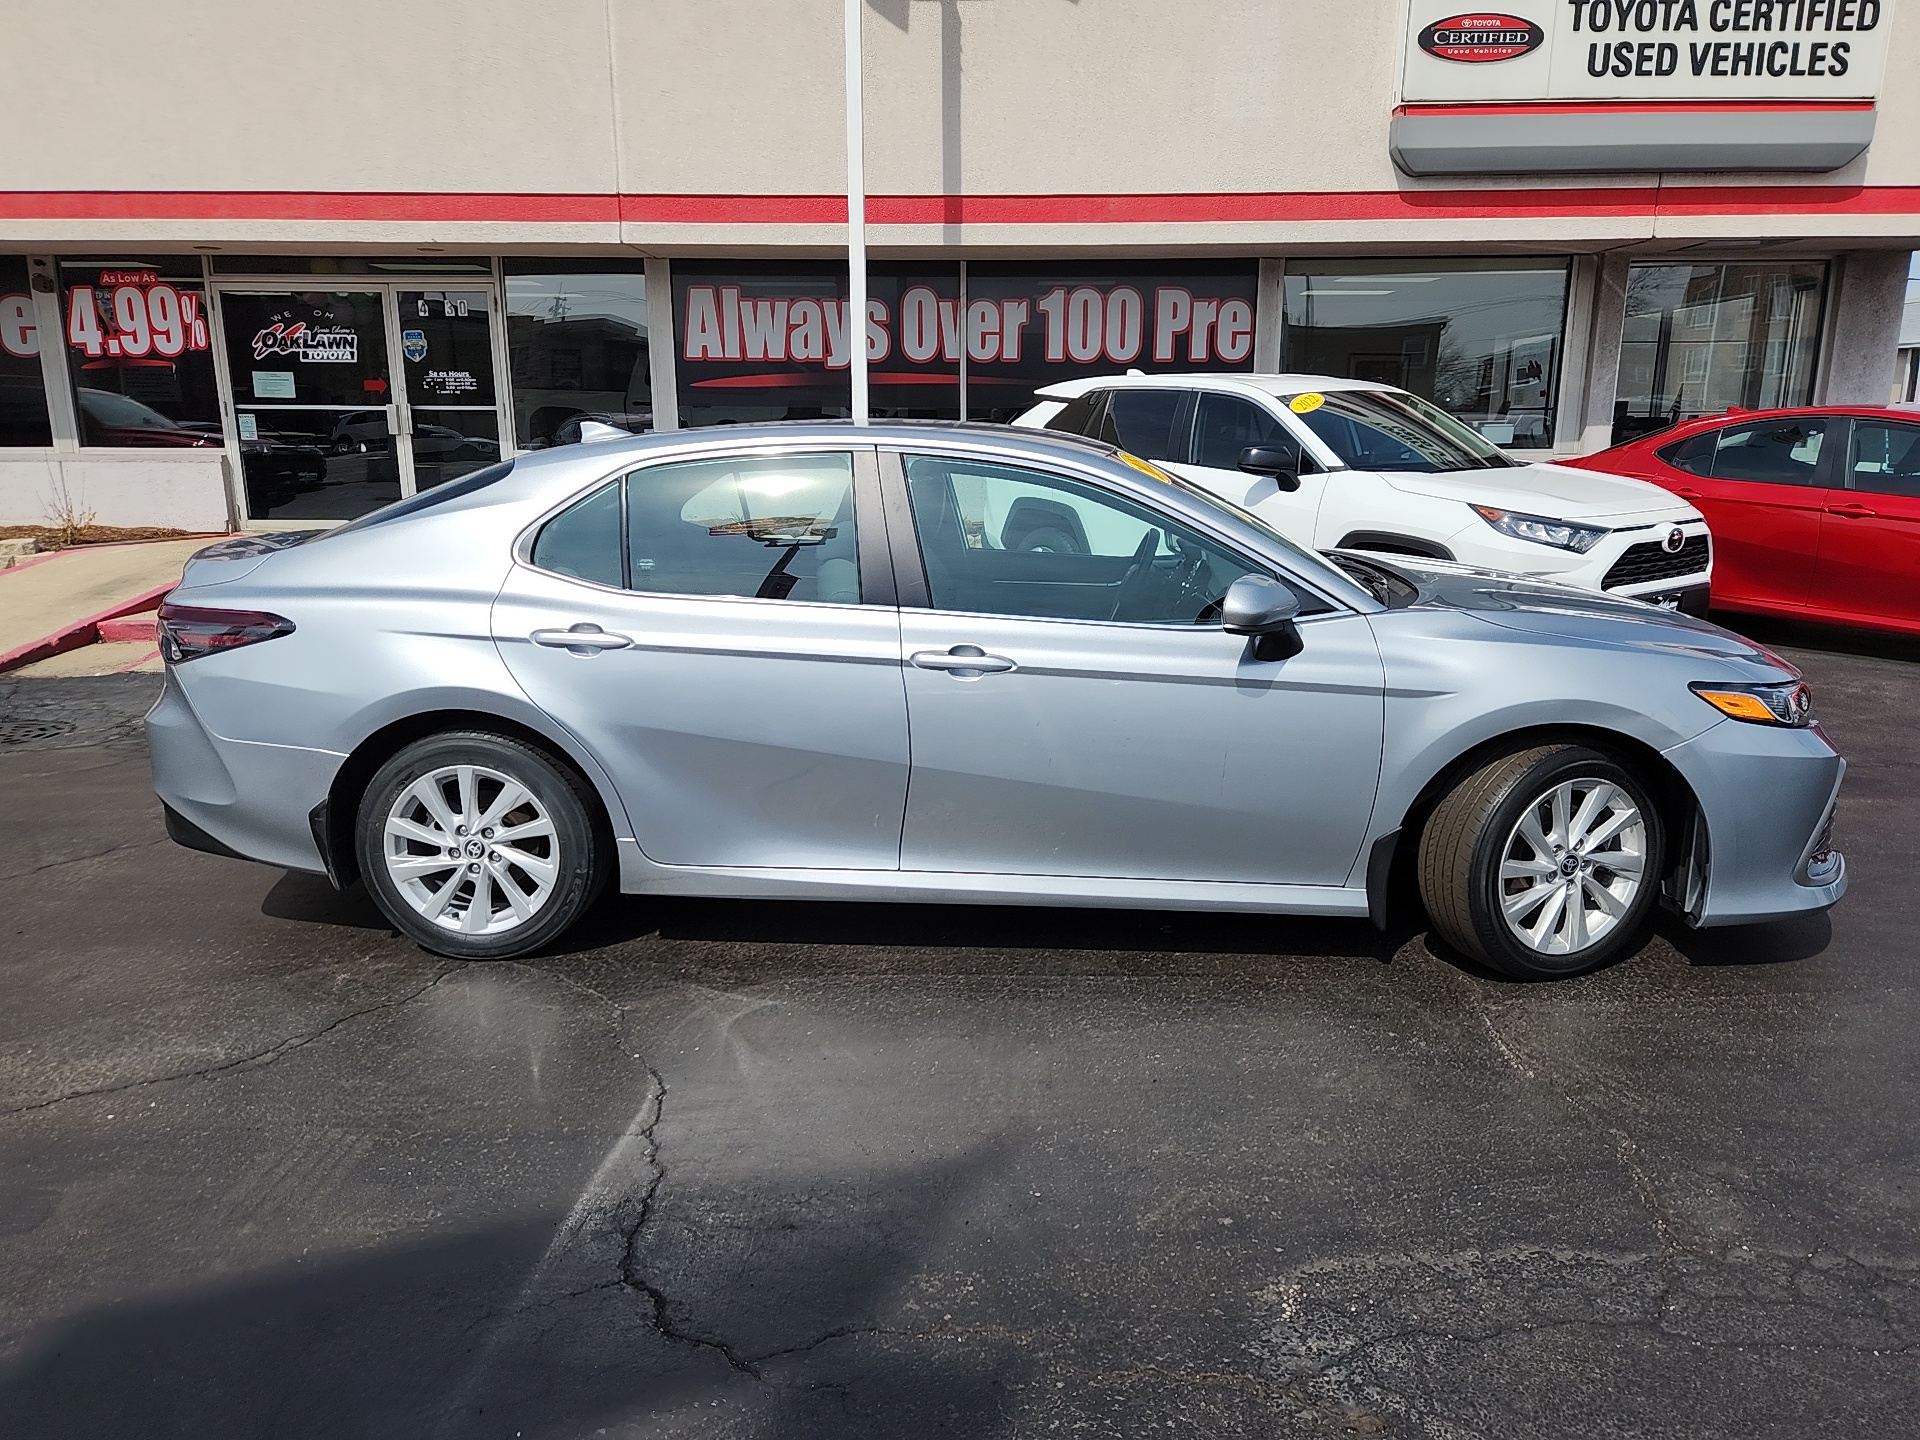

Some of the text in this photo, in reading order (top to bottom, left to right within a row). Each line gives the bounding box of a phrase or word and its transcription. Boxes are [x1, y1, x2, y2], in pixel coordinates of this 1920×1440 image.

[1473, 19, 1501, 27] TOYOTA
[1568, 0, 1880, 32] TOYOTA CERTIFIED
[1433, 30, 1530, 45] CERTIFIED
[1587, 40, 1850, 77] USED VEHICLES
[68, 285, 207, 356] 4.99%
[684, 286, 1252, 368] Always Over 100 Pre
[306, 350, 352, 360] TOYOTA
